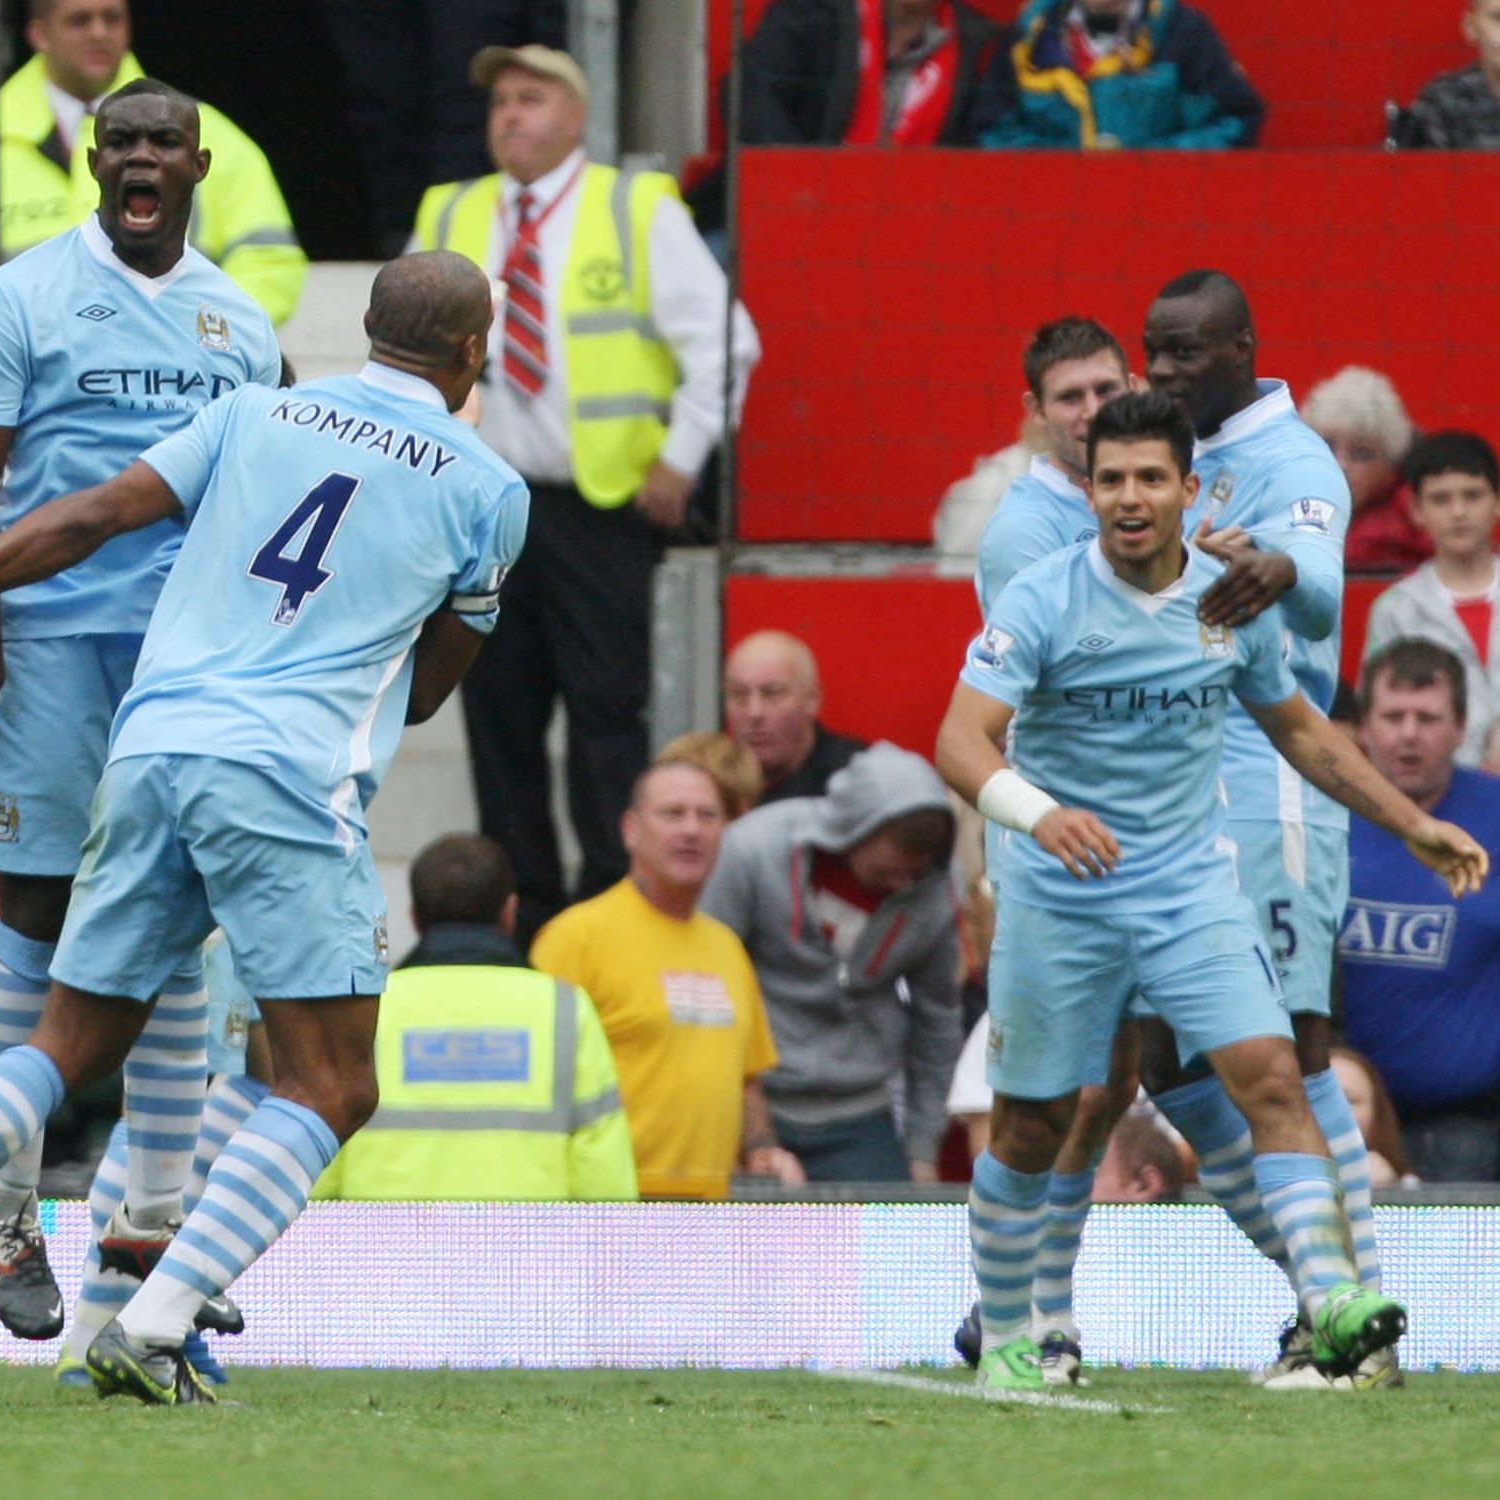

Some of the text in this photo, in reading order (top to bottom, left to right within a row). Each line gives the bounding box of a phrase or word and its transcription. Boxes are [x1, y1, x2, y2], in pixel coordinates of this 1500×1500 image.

[77, 369, 236, 399] ETIHAD
[107, 399, 212, 413] AIRWAY
[270, 399, 457, 478] KOMPANY
[246, 469, 363, 629] 4
[1063, 685, 1225, 710] ETIHAD
[1338, 906, 1443, 954] AIG
